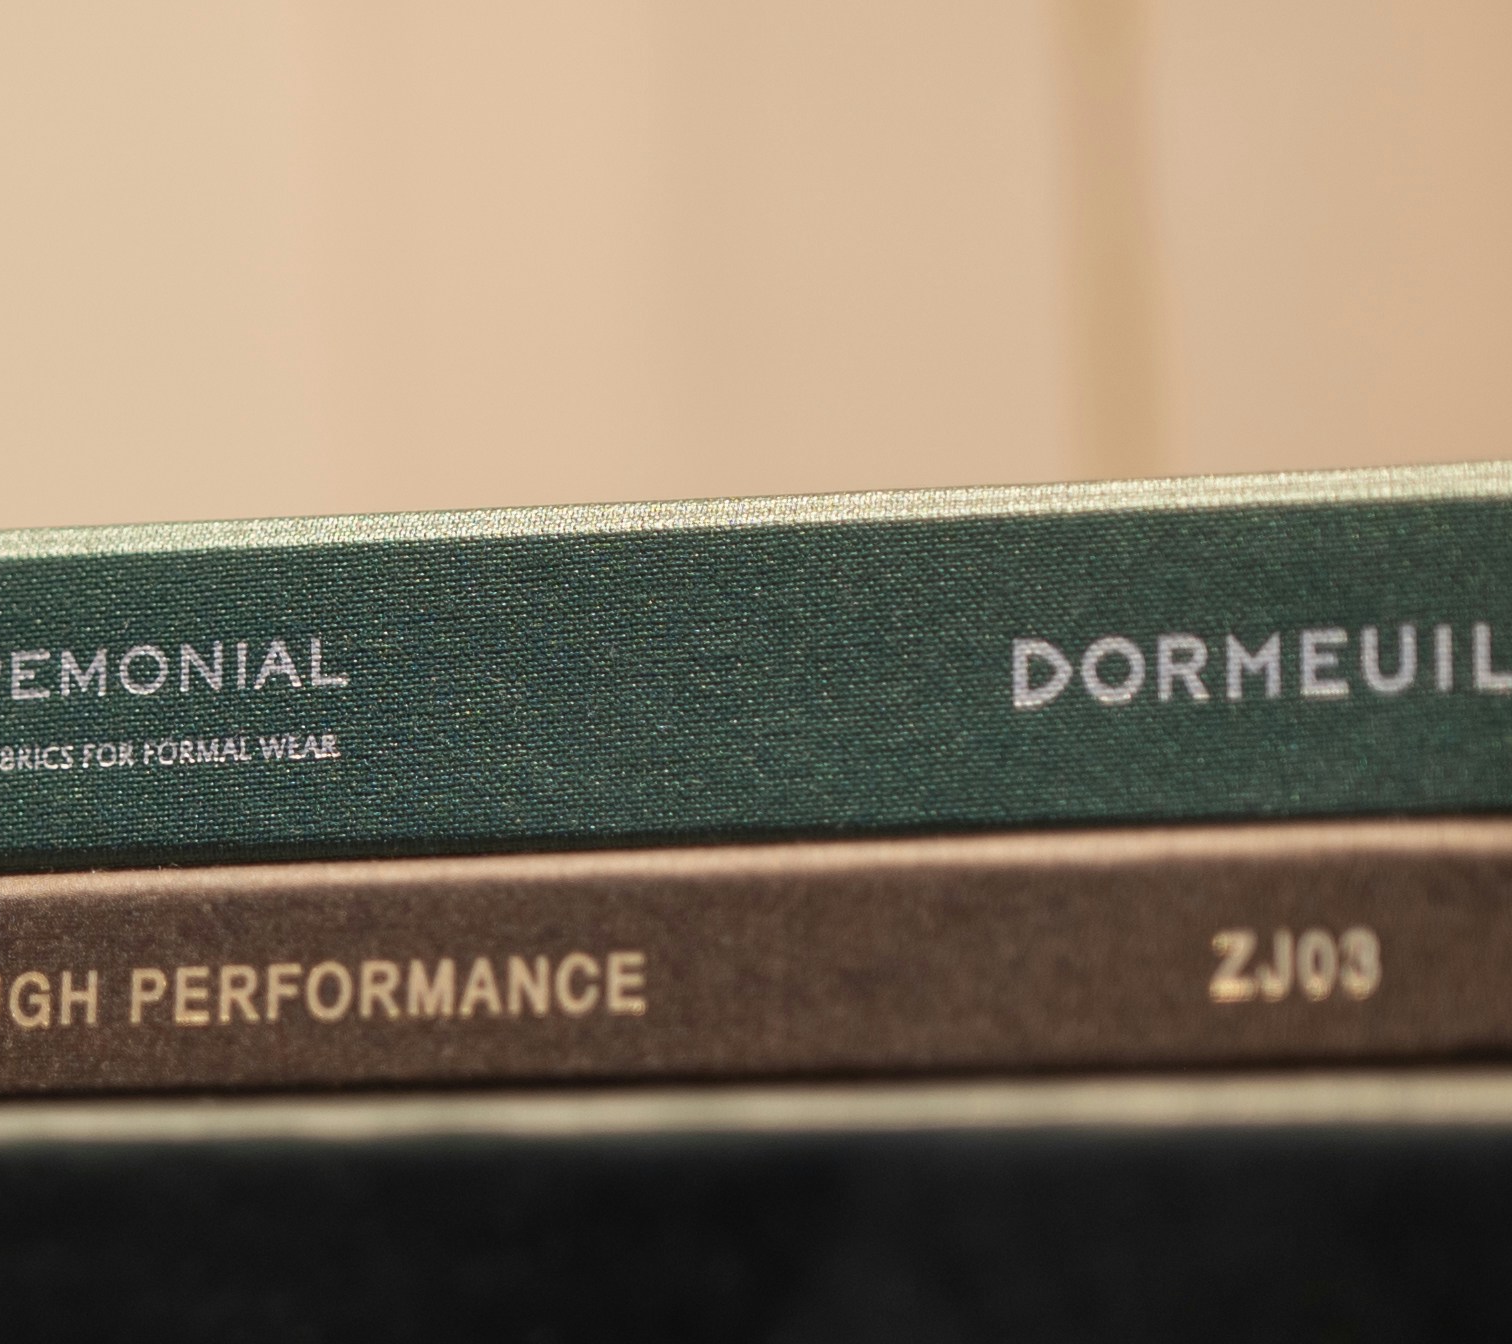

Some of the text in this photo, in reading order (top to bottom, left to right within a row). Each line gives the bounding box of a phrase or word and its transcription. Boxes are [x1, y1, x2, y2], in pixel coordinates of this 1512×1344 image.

[82, 742, 138, 770] FOR
[142, 736, 252, 766] FORMAL
[257, 732, 342, 762] WEAR
[131, 951, 647, 1026] PERFORMANCE
[1208, 926, 1382, 1003] ZJ03
